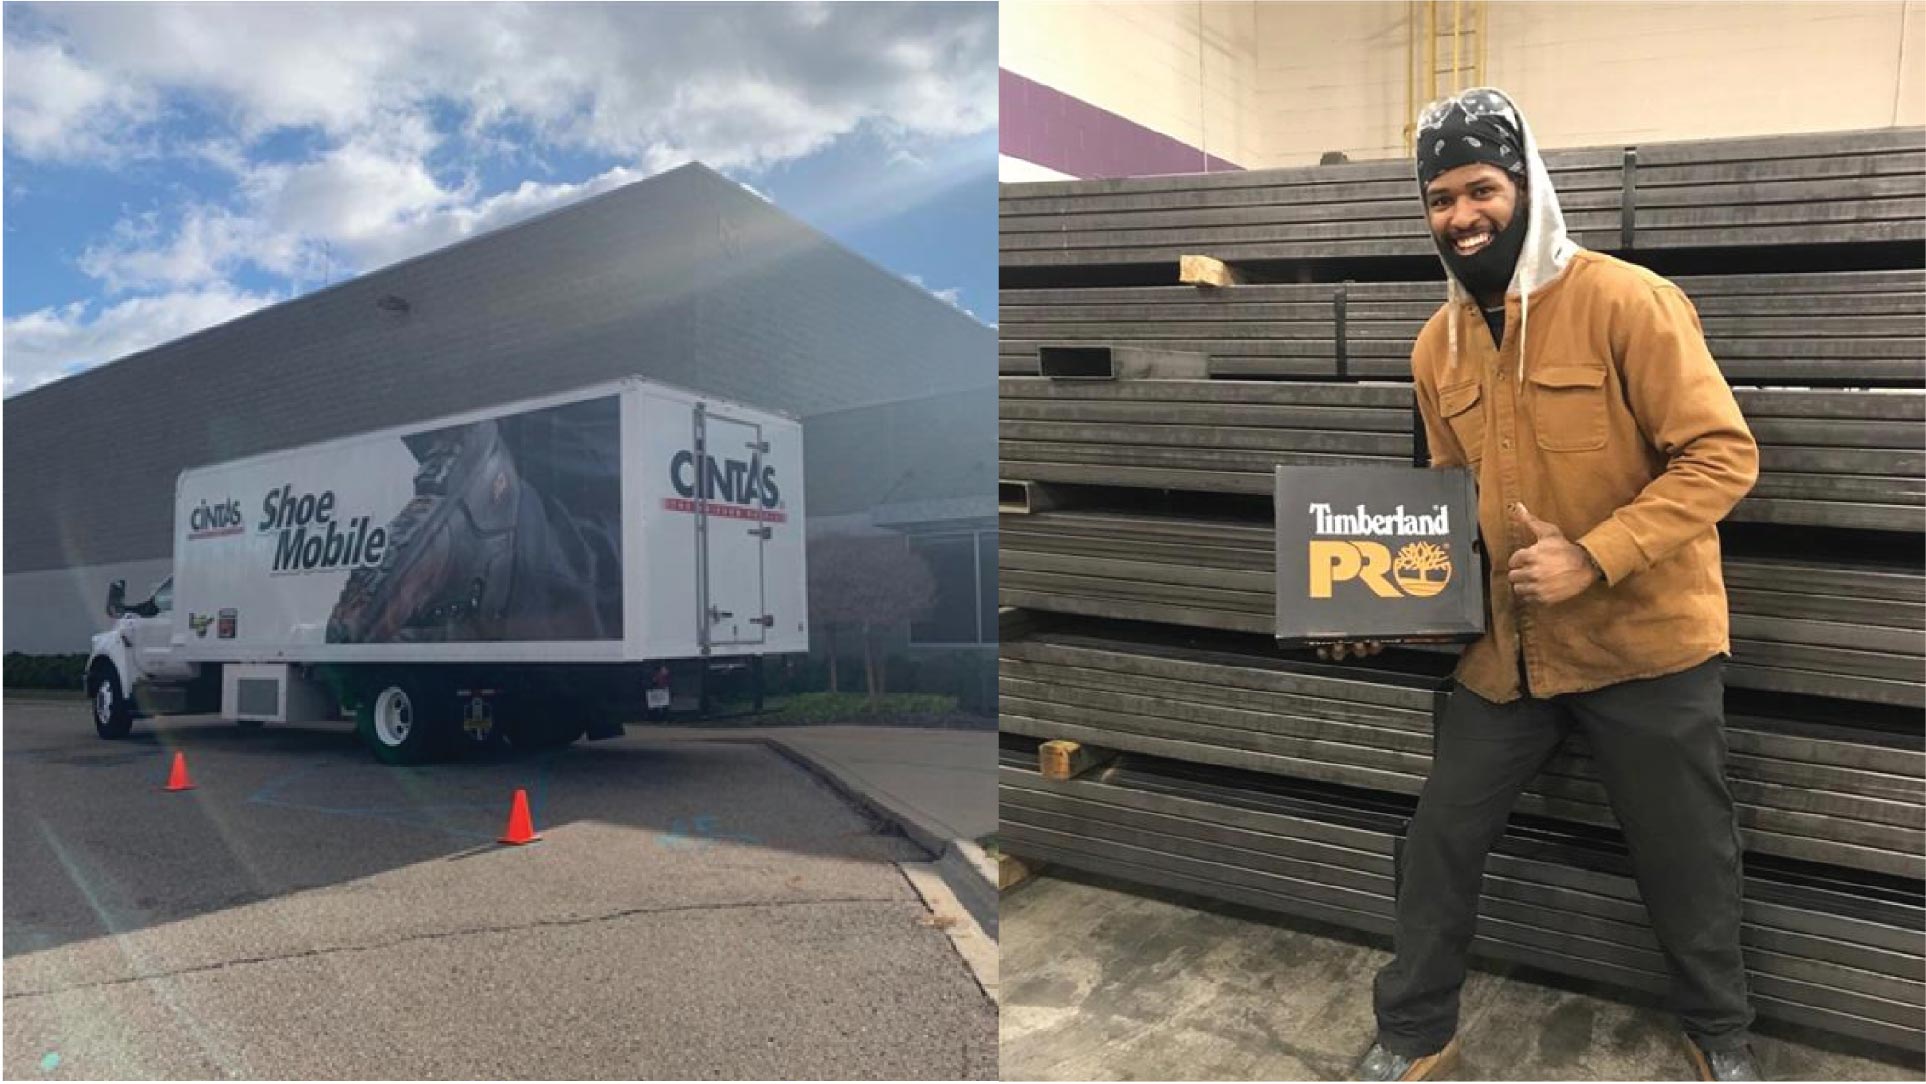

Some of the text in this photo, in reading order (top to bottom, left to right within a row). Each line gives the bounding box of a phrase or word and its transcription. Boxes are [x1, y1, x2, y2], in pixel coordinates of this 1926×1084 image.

[670, 440, 781, 508] CINTAS
[191, 497, 242, 531] CINTAS
[258, 483, 335, 532] Shoe
[1309, 502, 1450, 536] Timberland
[271, 515, 386, 572] Mobile
[1309, 540, 1453, 598] PRO
